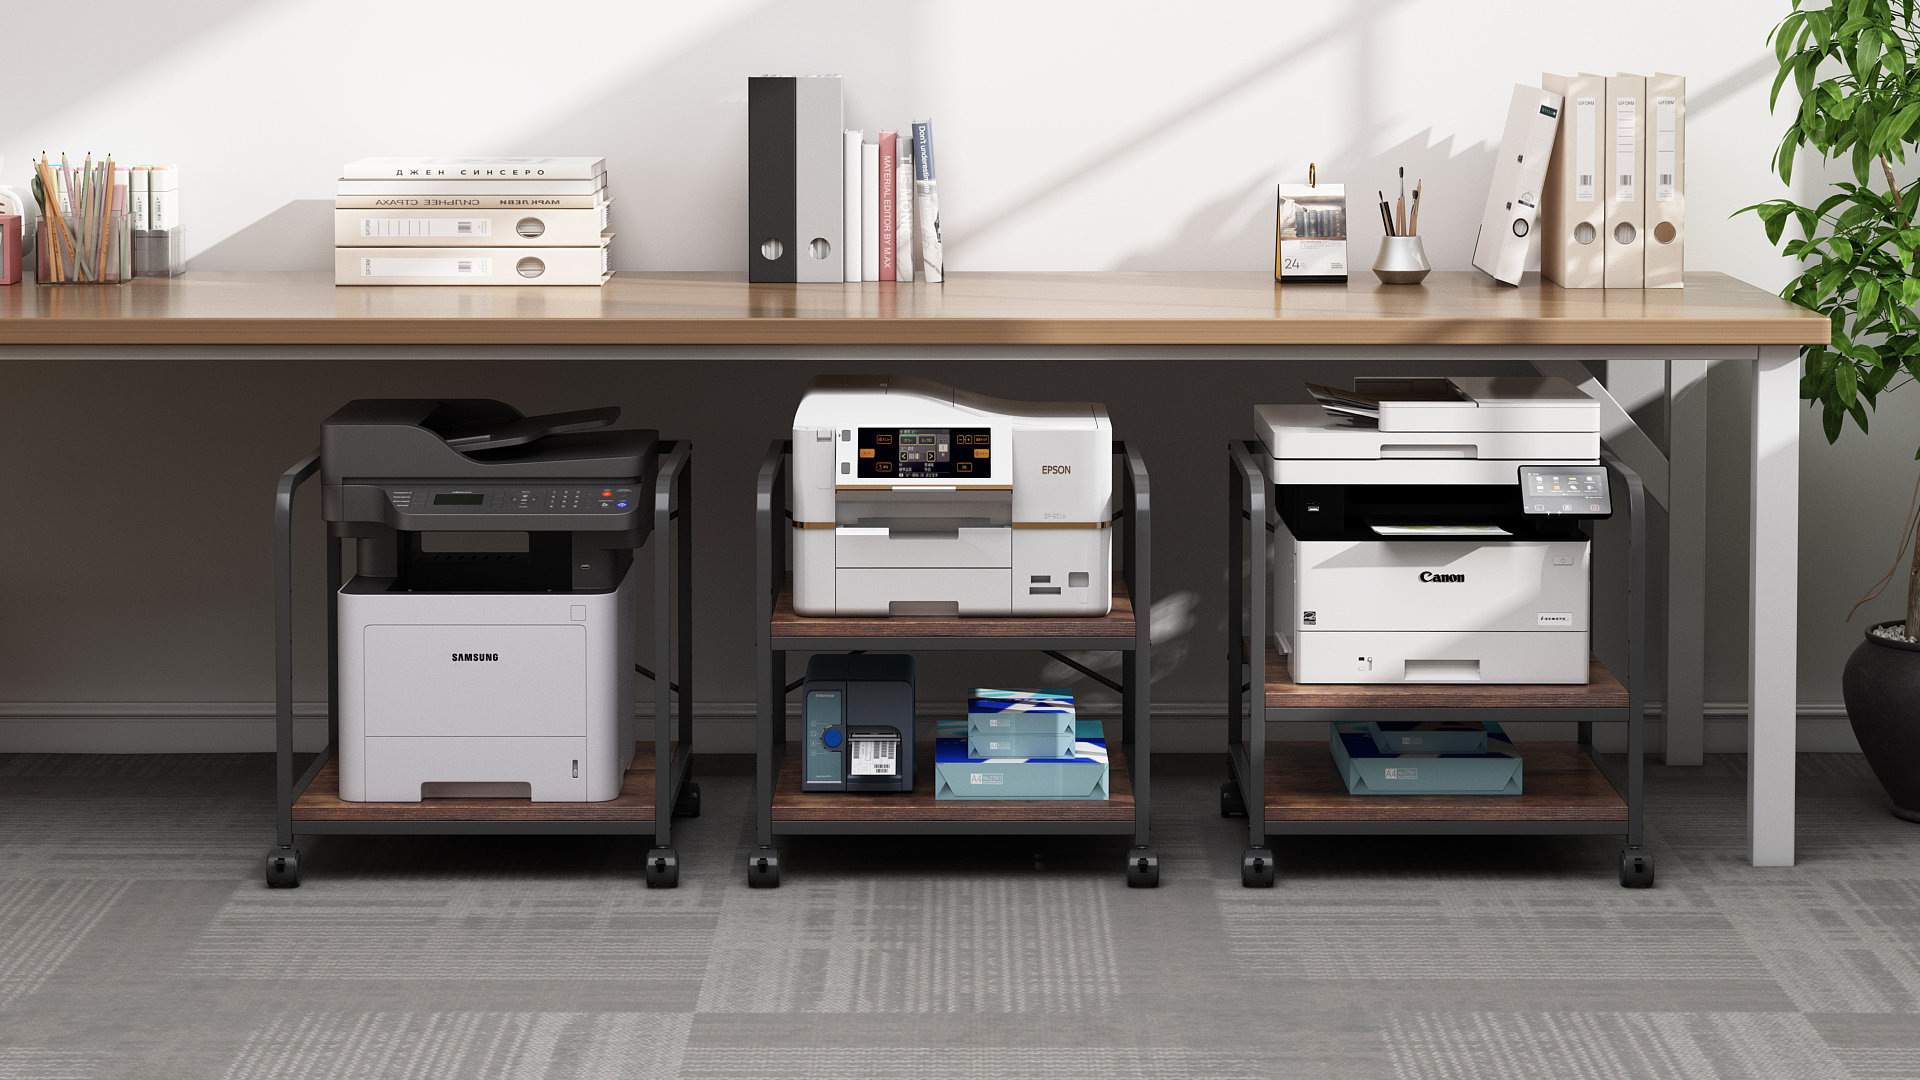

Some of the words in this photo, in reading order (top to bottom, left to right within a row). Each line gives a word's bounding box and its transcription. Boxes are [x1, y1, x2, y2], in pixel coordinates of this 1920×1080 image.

[918, 125, 927, 144] Don't
[900, 153, 912, 184] THE
[883, 155, 891, 198] MATERIAL
[883, 199, 891, 232] EDITOR
[900, 188, 912, 235] MONK
[883, 233, 891, 245] BY
[883, 247, 891, 268] M.AX
[1284, 258, 1300, 269] 24
[1041, 465, 1071, 475] EPSON
[1418, 571, 1465, 584] Canon
[451, 653, 499, 662] SAMSUNG
[971, 774, 982, 783] A4
[1385, 769, 1396, 778] A4
